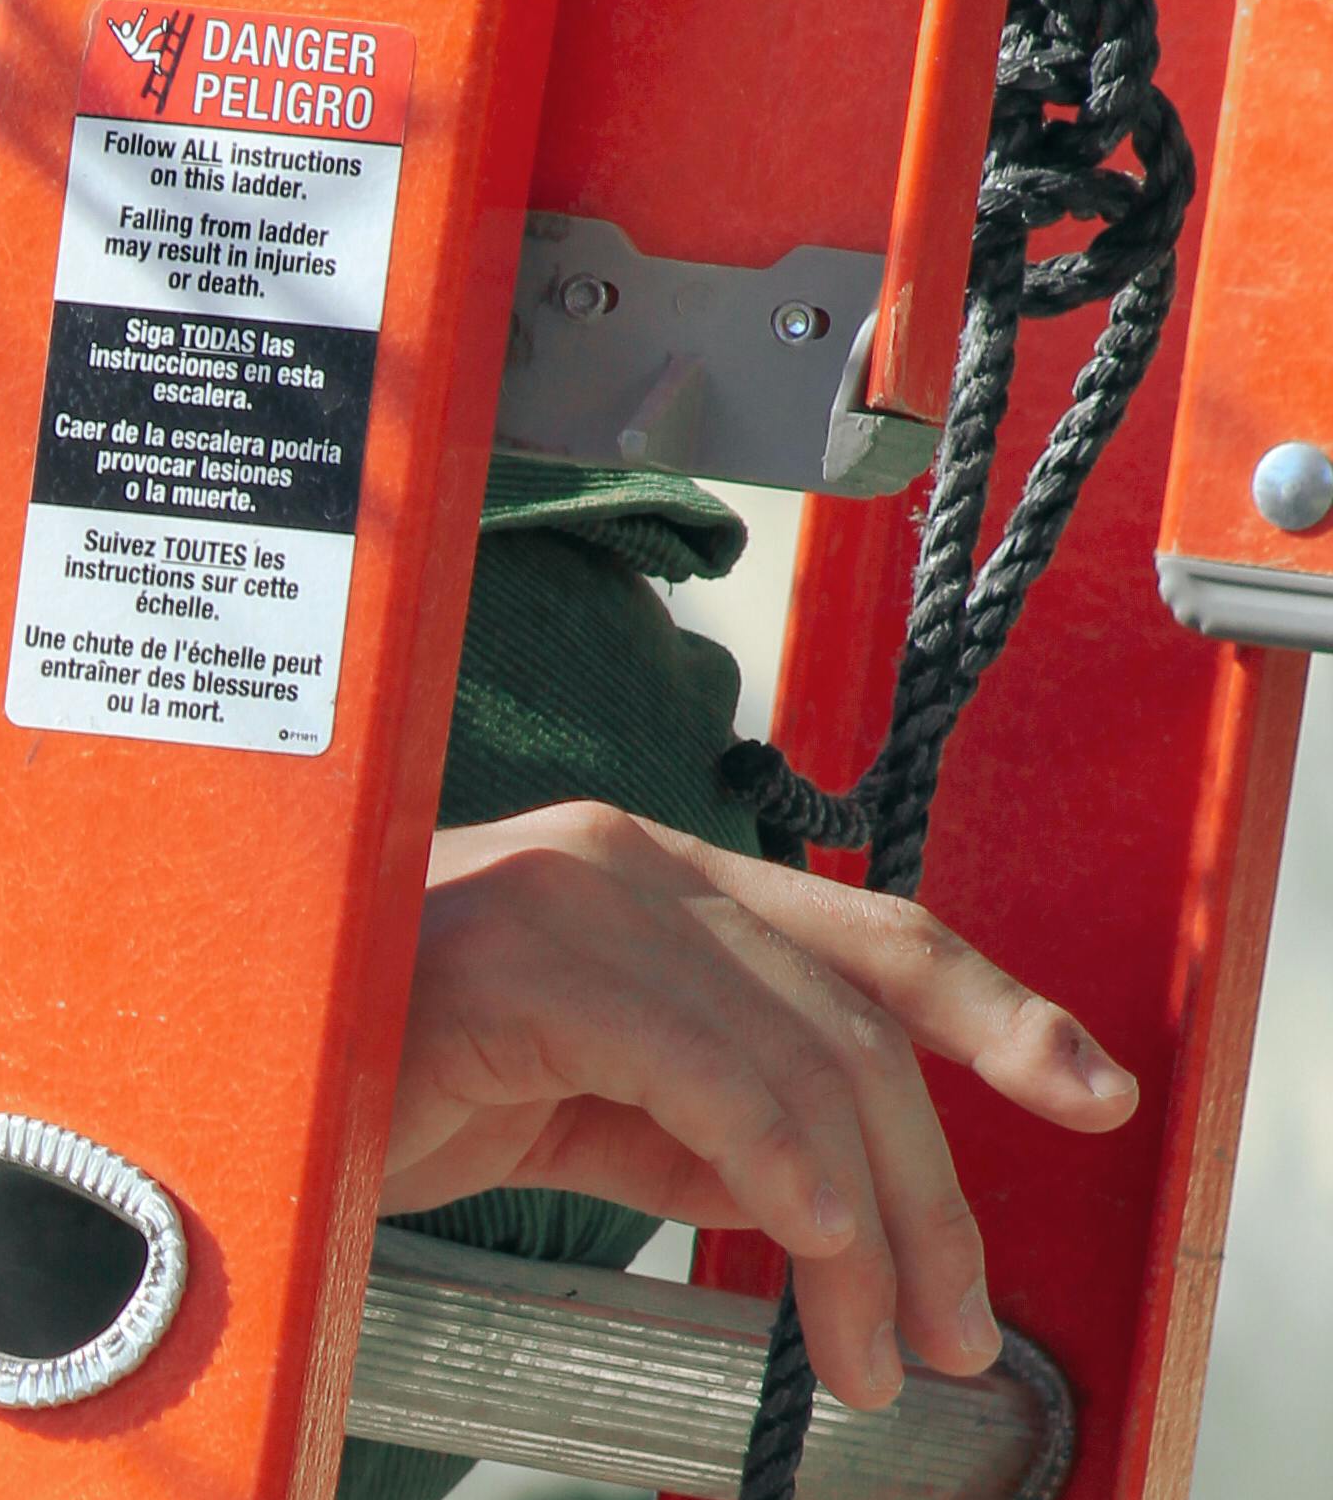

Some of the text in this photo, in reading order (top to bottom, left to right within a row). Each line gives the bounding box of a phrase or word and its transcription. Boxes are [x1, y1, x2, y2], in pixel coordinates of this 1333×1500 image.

[202, 20, 377, 76] DANGER
[192, 73, 374, 130] PELIGRO
[103, 131, 363, 174] Follow ALL instructions
[149, 167, 309, 198] on this ladder.
[118, 207, 329, 246] Falling from ladder
[103, 237, 337, 279] may result in injuries
[167, 269, 267, 296] or death.
[124, 319, 296, 356] Siga TODAS las
[89, 343, 326, 387] instrucciones en esta
[153, 379, 253, 410] escalera.
[54, 413, 342, 467] Caer de la escalera podría
[96, 451, 293, 486] provocar lesiones
[124, 479, 258, 511] o la muerte.
[83, 529, 286, 569] Suivez TOUTES les
[64, 555, 300, 599] instructions sur cette
[135, 590, 221, 619] échelle.
[24, 624, 323, 679] Une chute de l'échelle peut
[40, 654, 300, 701] entraîner des blessures
[106, 692, 226, 721] ou la mort.
